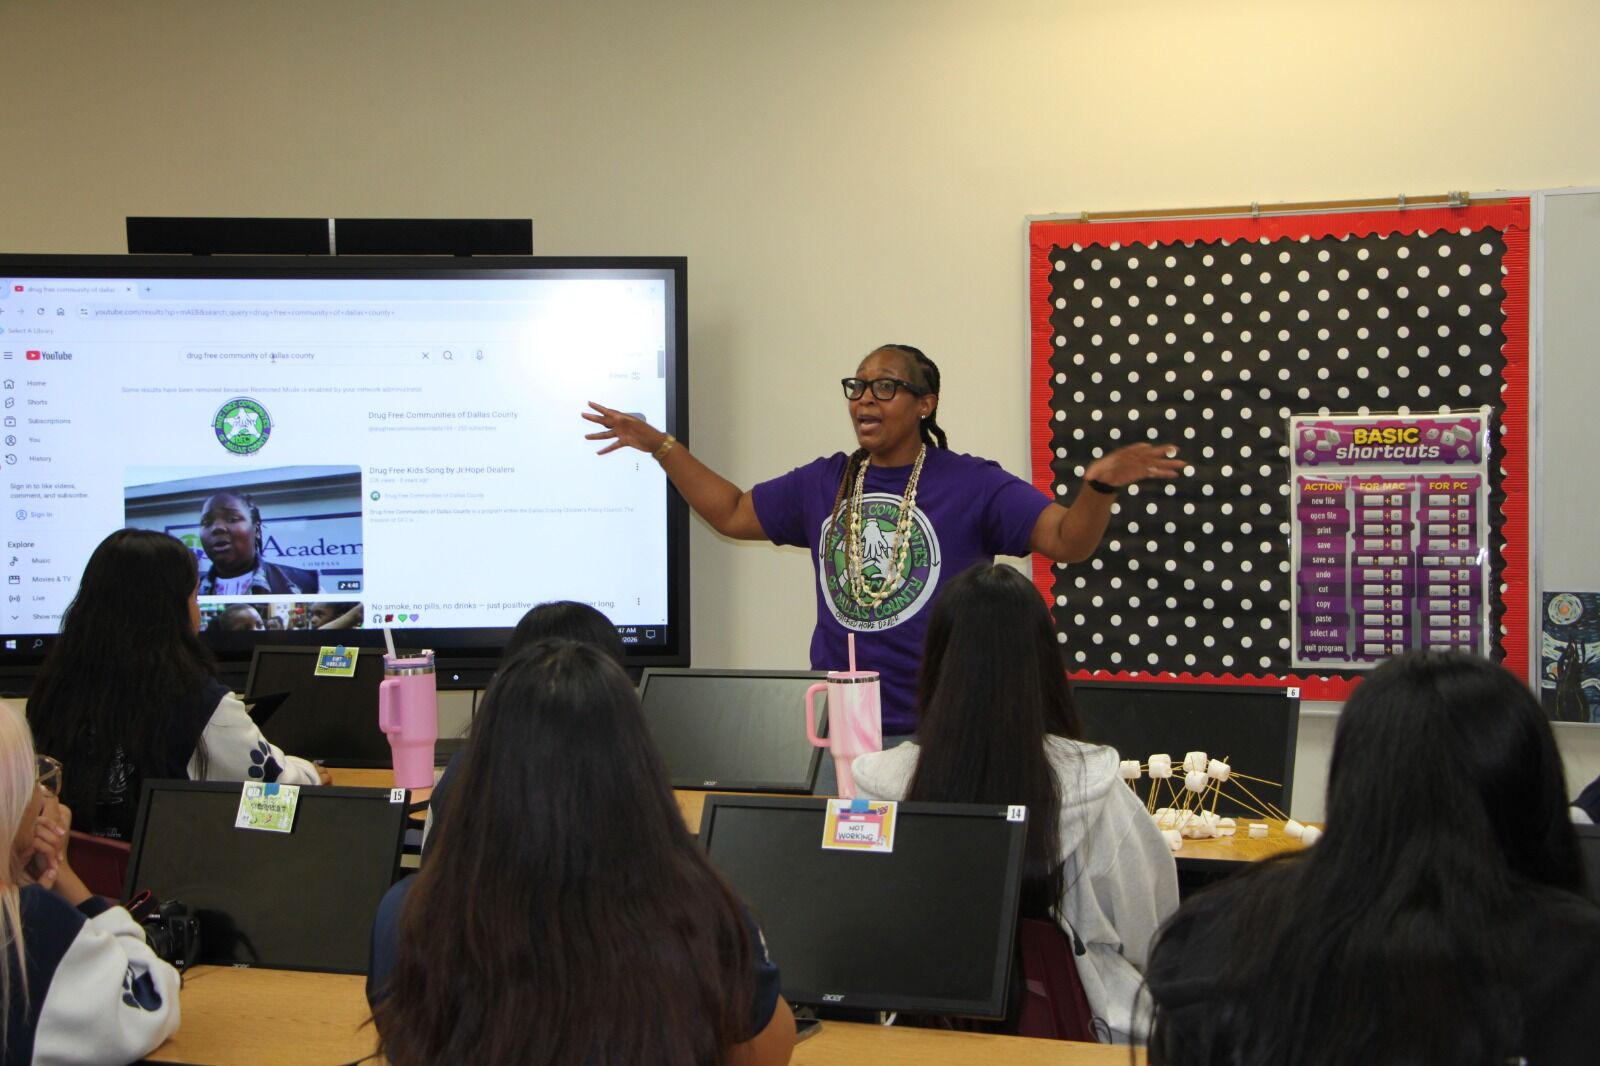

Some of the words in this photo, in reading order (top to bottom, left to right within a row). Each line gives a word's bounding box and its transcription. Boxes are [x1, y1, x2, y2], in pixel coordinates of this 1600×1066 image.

[42, 352, 72, 360] YouTube
[369, 411, 386, 420] Drug
[492, 411, 518, 420] County
[1354, 428, 1419, 445] BASIC
[1336, 443, 1440, 459] shortcuts
[370, 466, 387, 475] Drug
[425, 466, 444, 475] Song
[446, 466, 454, 474] by
[1304, 482, 1343, 491] ACTION
[1383, 482, 1405, 490] MAC
[1429, 482, 1450, 490] FOR
[1317, 527, 1331, 535] print
[8, 541, 35, 550] Explore
[384, 602, 411, 611] smoke,
[487, 602, 500, 610] just
[502, 601, 532, 610] positive
[598, 600, 616, 609] long.
[394, 791, 402, 800] 15
[1012, 808, 1021, 818] 14
